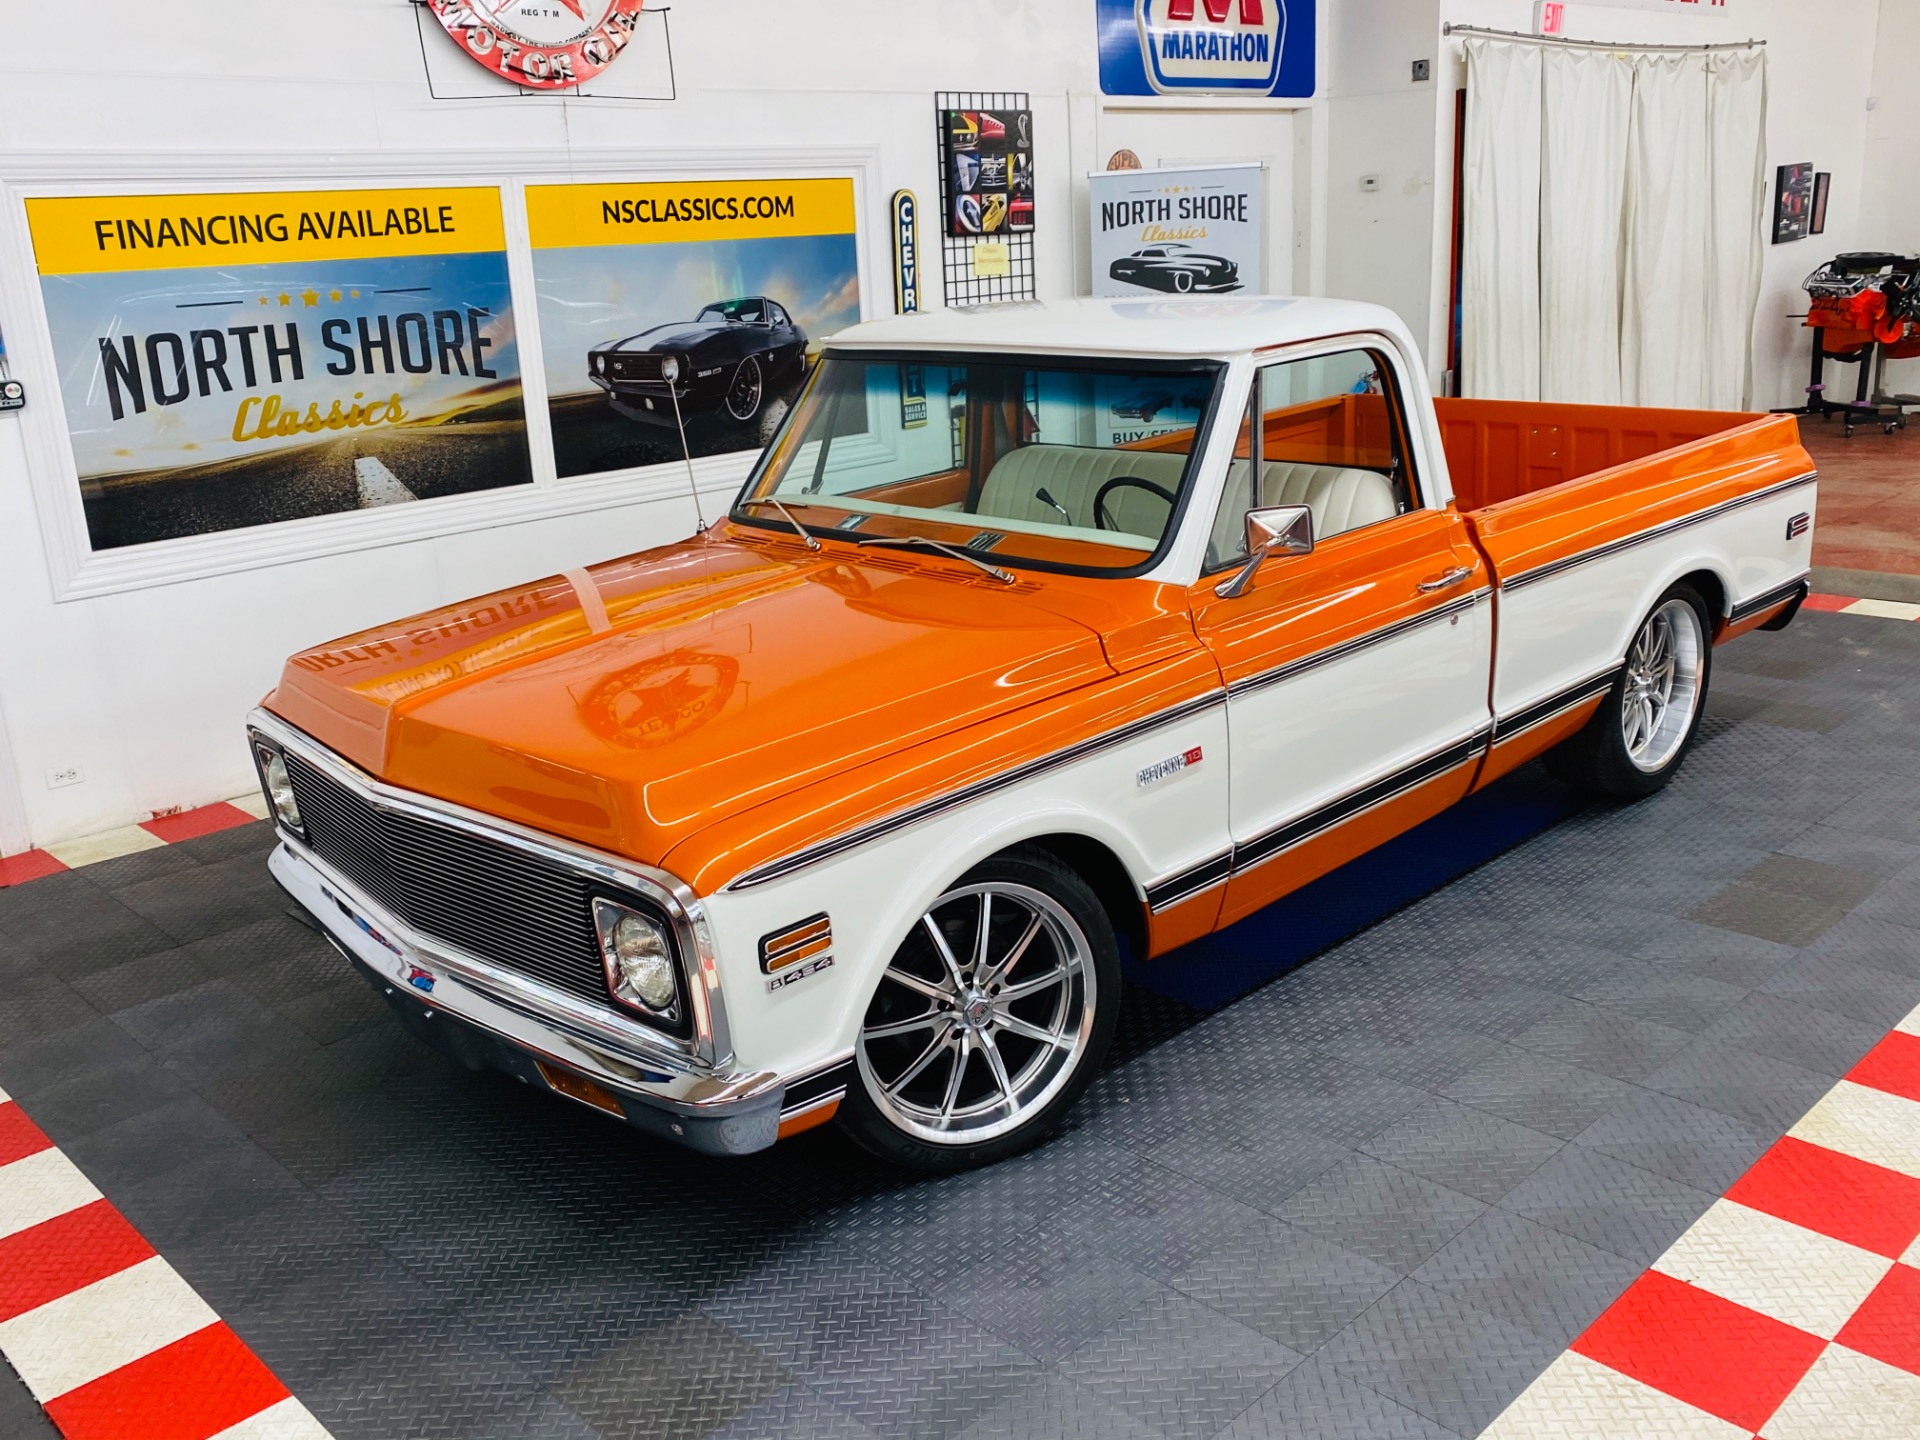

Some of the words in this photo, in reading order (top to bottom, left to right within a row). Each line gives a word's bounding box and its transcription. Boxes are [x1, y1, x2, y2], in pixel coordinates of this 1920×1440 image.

[1543, 3, 1564, 32] EXIT
[1162, 30, 1269, 62] MARATHON
[602, 196, 795, 224] NSCLASSICS.COM
[1102, 198, 1171, 232] NORTH
[1178, 194, 1248, 223] SHORE
[95, 213, 288, 250] FINANCING
[298, 206, 455, 241] AVAILABLE
[1140, 224, 1208, 243] Classics
[99, 322, 304, 421] NORTH
[321, 308, 497, 379] SHORE
[231, 391, 410, 442] Classics
[905, 404, 921, 413] SALES
[905, 411, 926, 421] SERVICE
